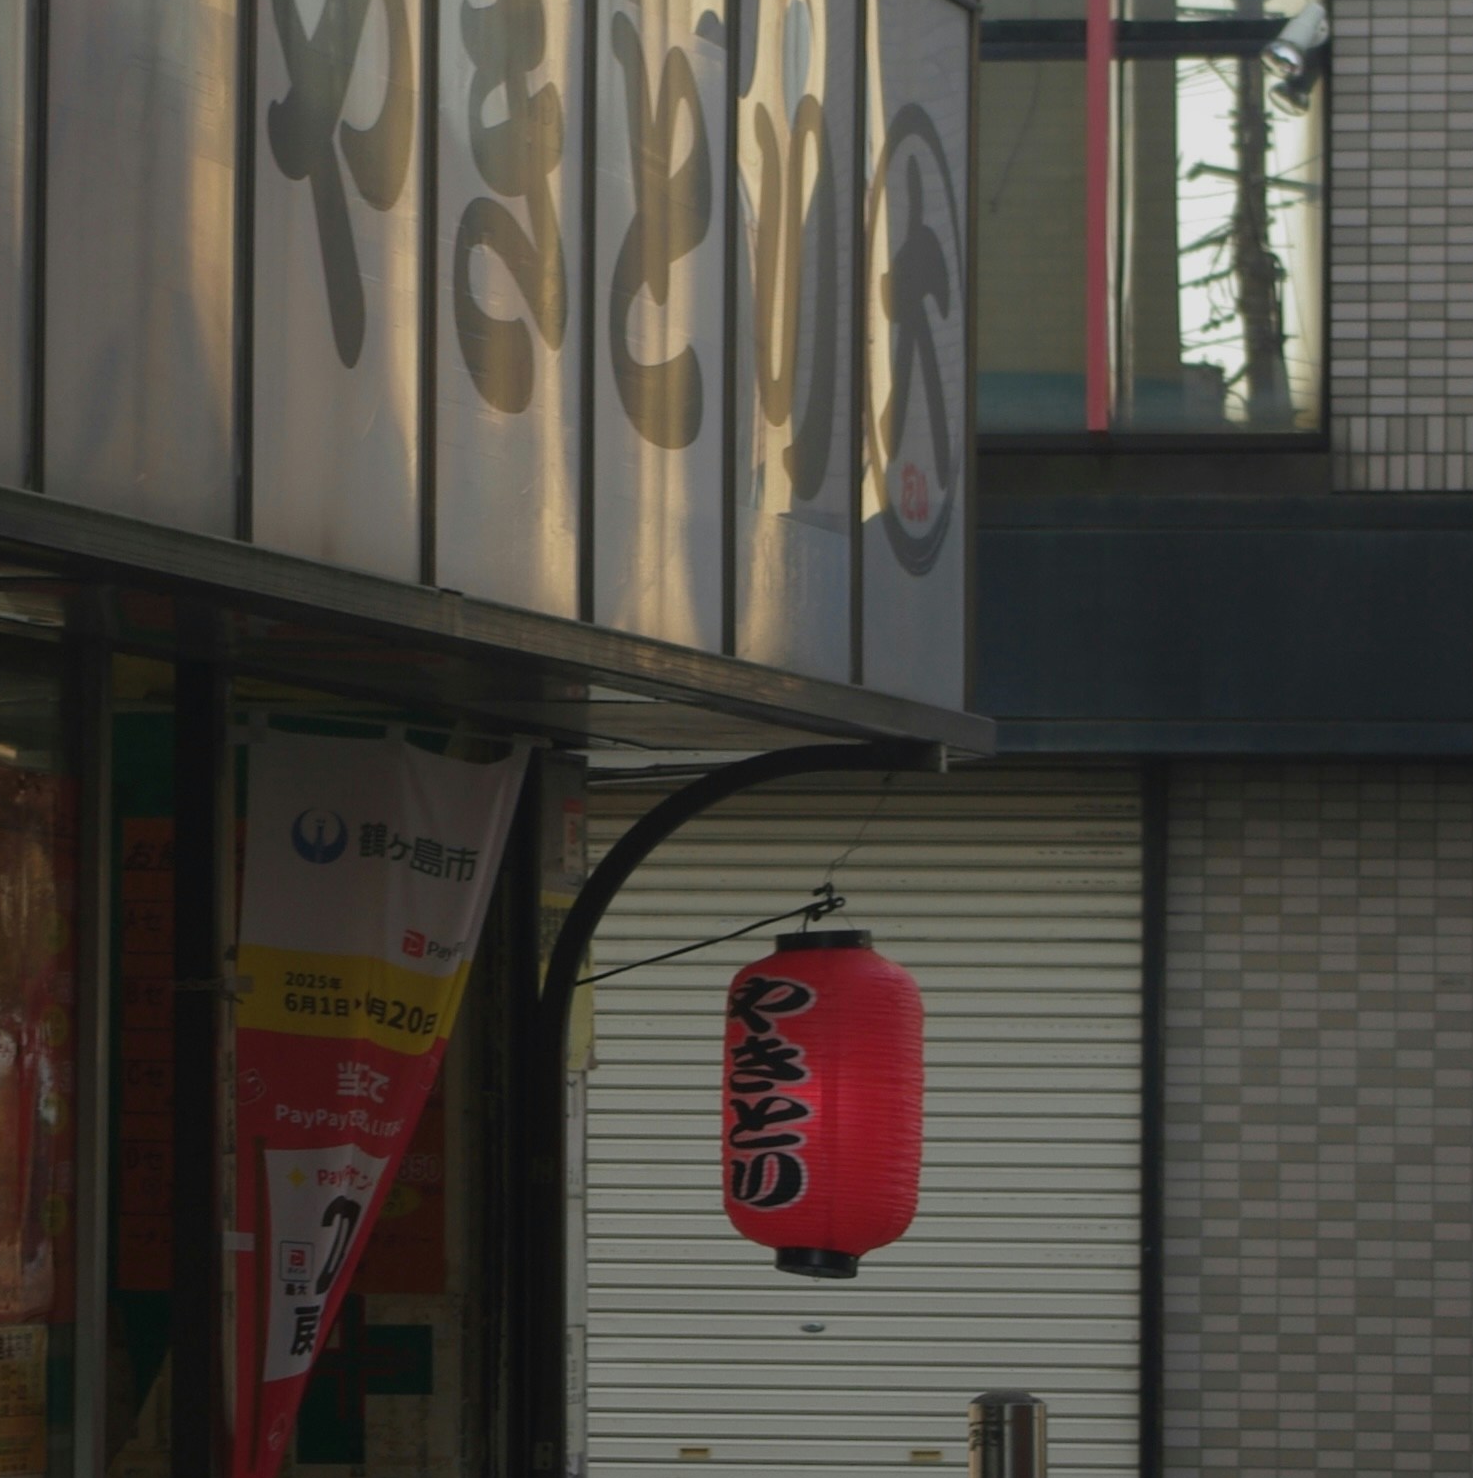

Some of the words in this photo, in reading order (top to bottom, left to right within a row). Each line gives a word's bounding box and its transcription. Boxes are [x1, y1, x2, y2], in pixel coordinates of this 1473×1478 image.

[358, 819, 480, 883] 鶴ヶ島市
[284, 971, 343, 991] 2025年
[284, 993, 350, 1018] 6月1日
[365, 990, 439, 1036] 月20日
[728, 975, 811, 1209] やきとり
